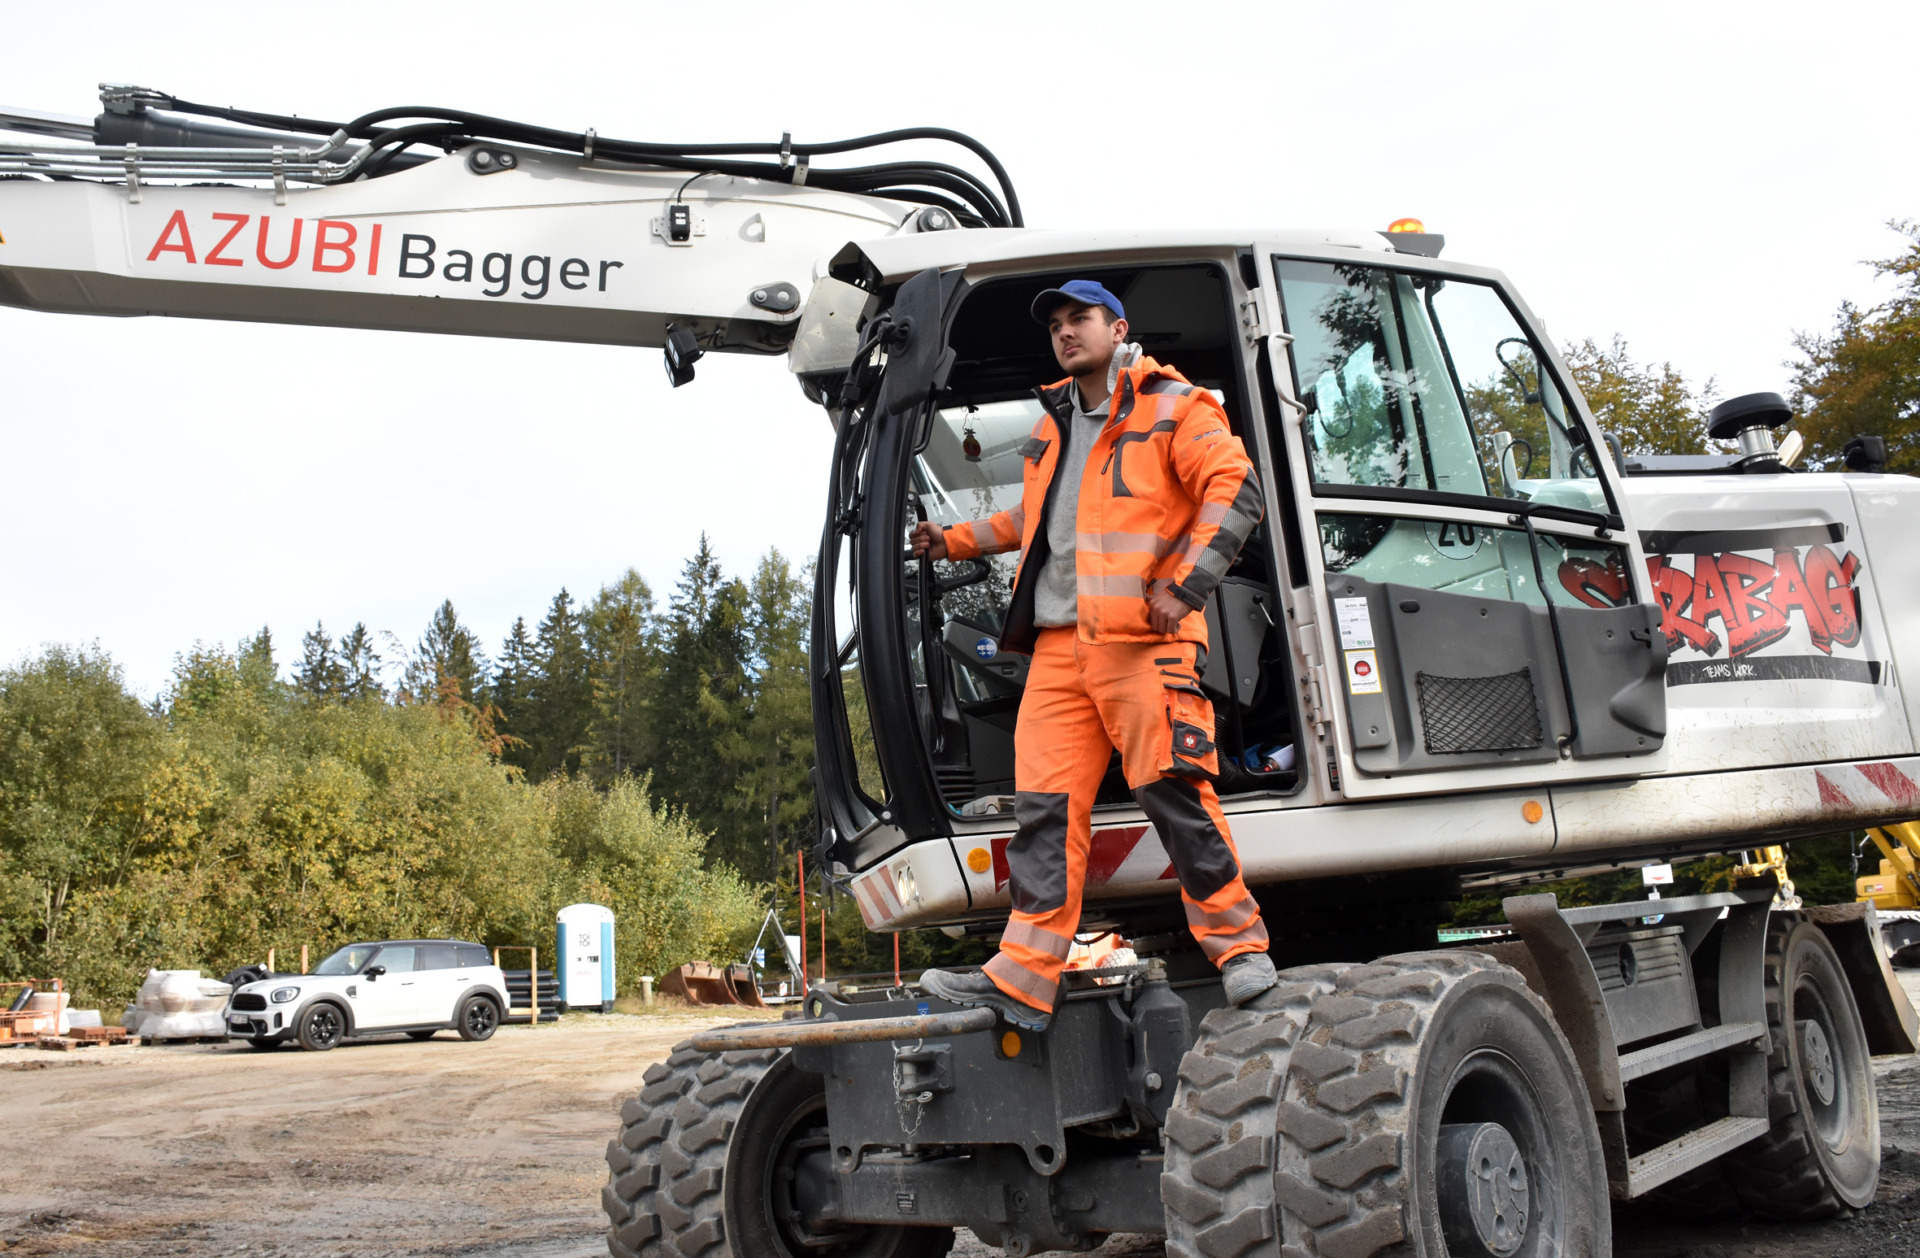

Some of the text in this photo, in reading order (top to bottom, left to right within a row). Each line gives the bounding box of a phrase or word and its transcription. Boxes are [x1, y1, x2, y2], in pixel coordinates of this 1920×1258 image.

[146, 209, 625, 300] AZUBI Bagger
[1702, 663, 1731, 678] TEAMS
